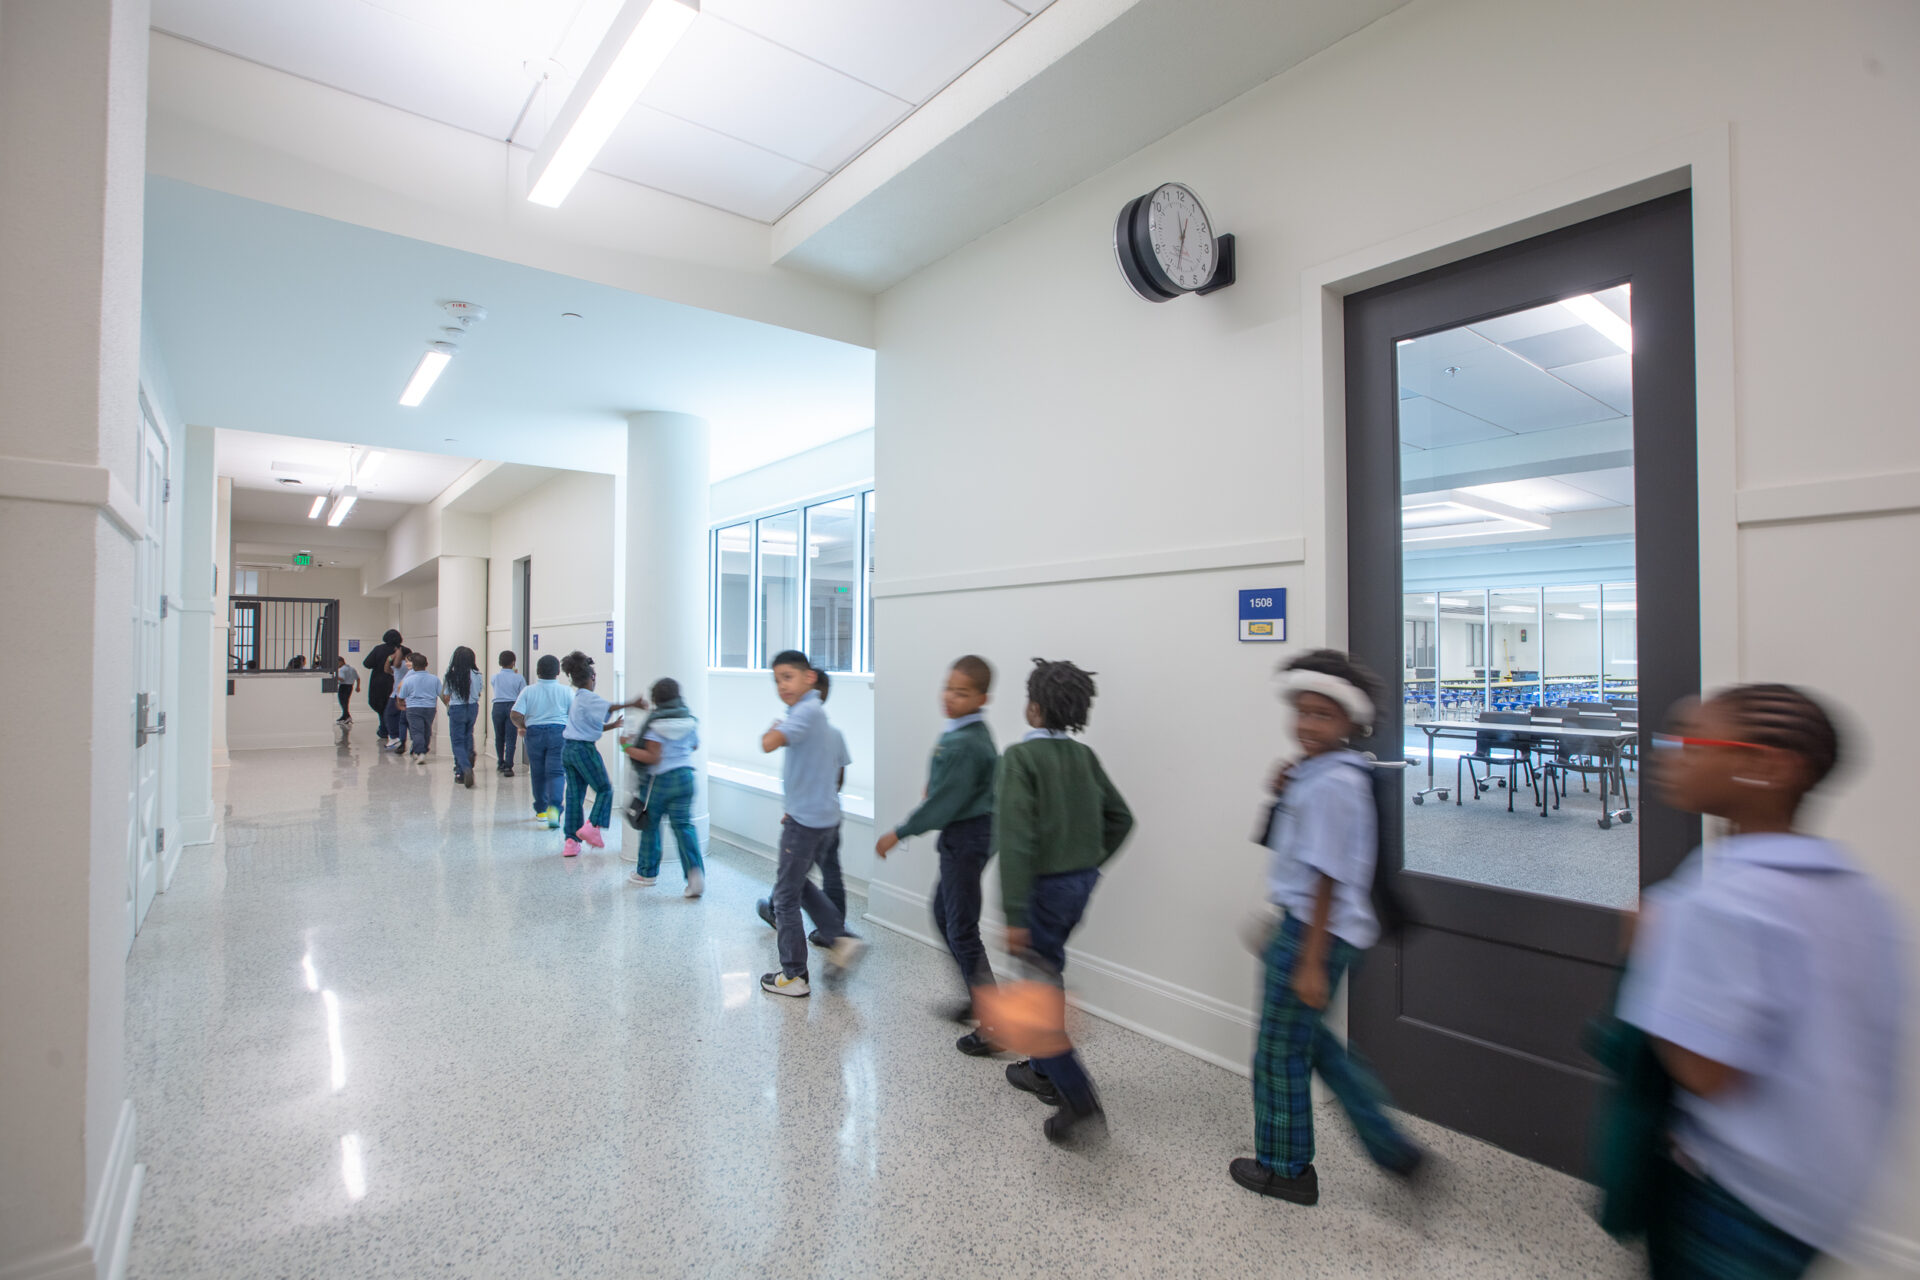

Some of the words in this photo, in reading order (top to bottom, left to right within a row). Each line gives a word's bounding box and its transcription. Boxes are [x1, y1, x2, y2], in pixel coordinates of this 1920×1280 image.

[1162, 190, 1170, 201] 11
[1176, 190, 1185, 202] 12
[1151, 200, 1162, 213] 10
[1201, 222, 1207, 233] 2
[1155, 243, 1161, 254] 8
[1204, 244, 1210, 254] 3
[1165, 263, 1171, 273] 7
[1201, 263, 1206, 272] 4
[1179, 275, 1185, 285] 6
[1193, 275, 1198, 285] 5
[1249, 597, 1273, 608] 1508
